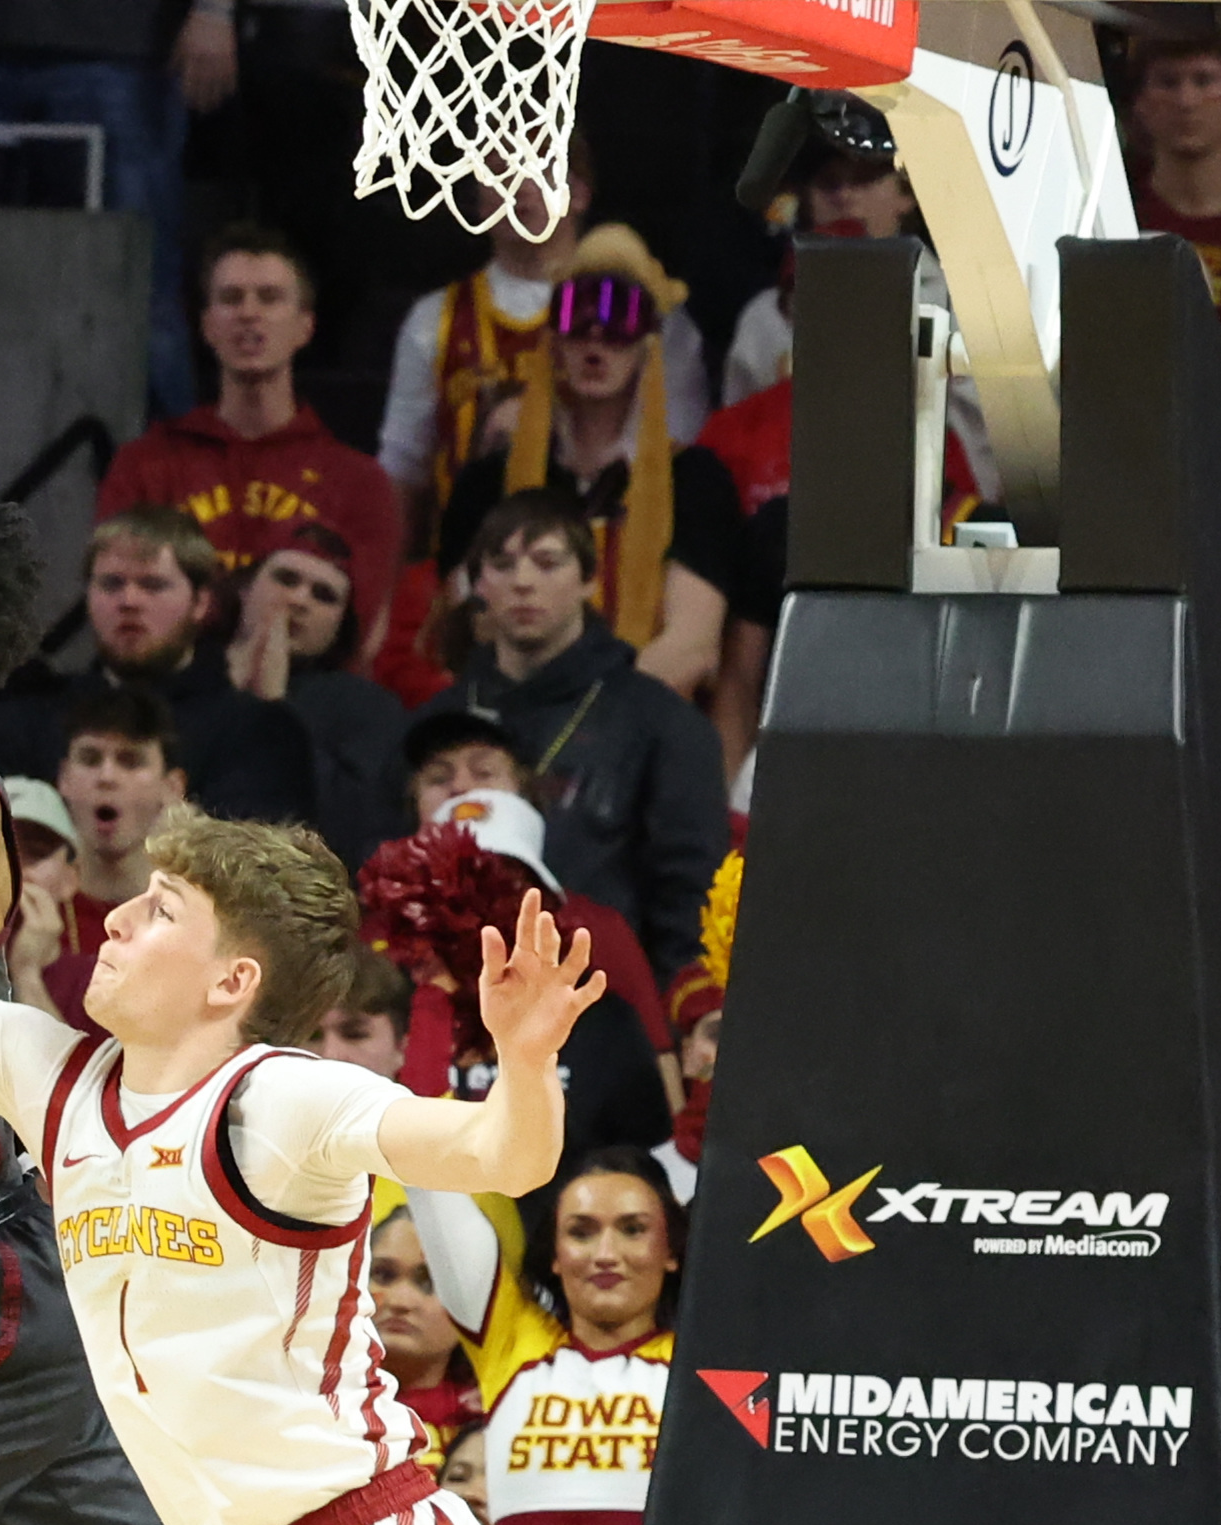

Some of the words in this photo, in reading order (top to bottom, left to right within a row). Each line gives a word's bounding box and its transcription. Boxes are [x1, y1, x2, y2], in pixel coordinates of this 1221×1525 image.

[865, 1182, 1170, 1227] XTREAM
[974, 1237, 1027, 1255] POWERED
[1027, 1238, 1044, 1255] BY
[1044, 1233, 1151, 1258] Mediacom
[525, 1393, 661, 1429] IOWA
[777, 1372, 1193, 1428] MIDAMERICAN
[774, 1417, 949, 1457] ENERGY
[958, 1423, 1190, 1467] COMPANY
